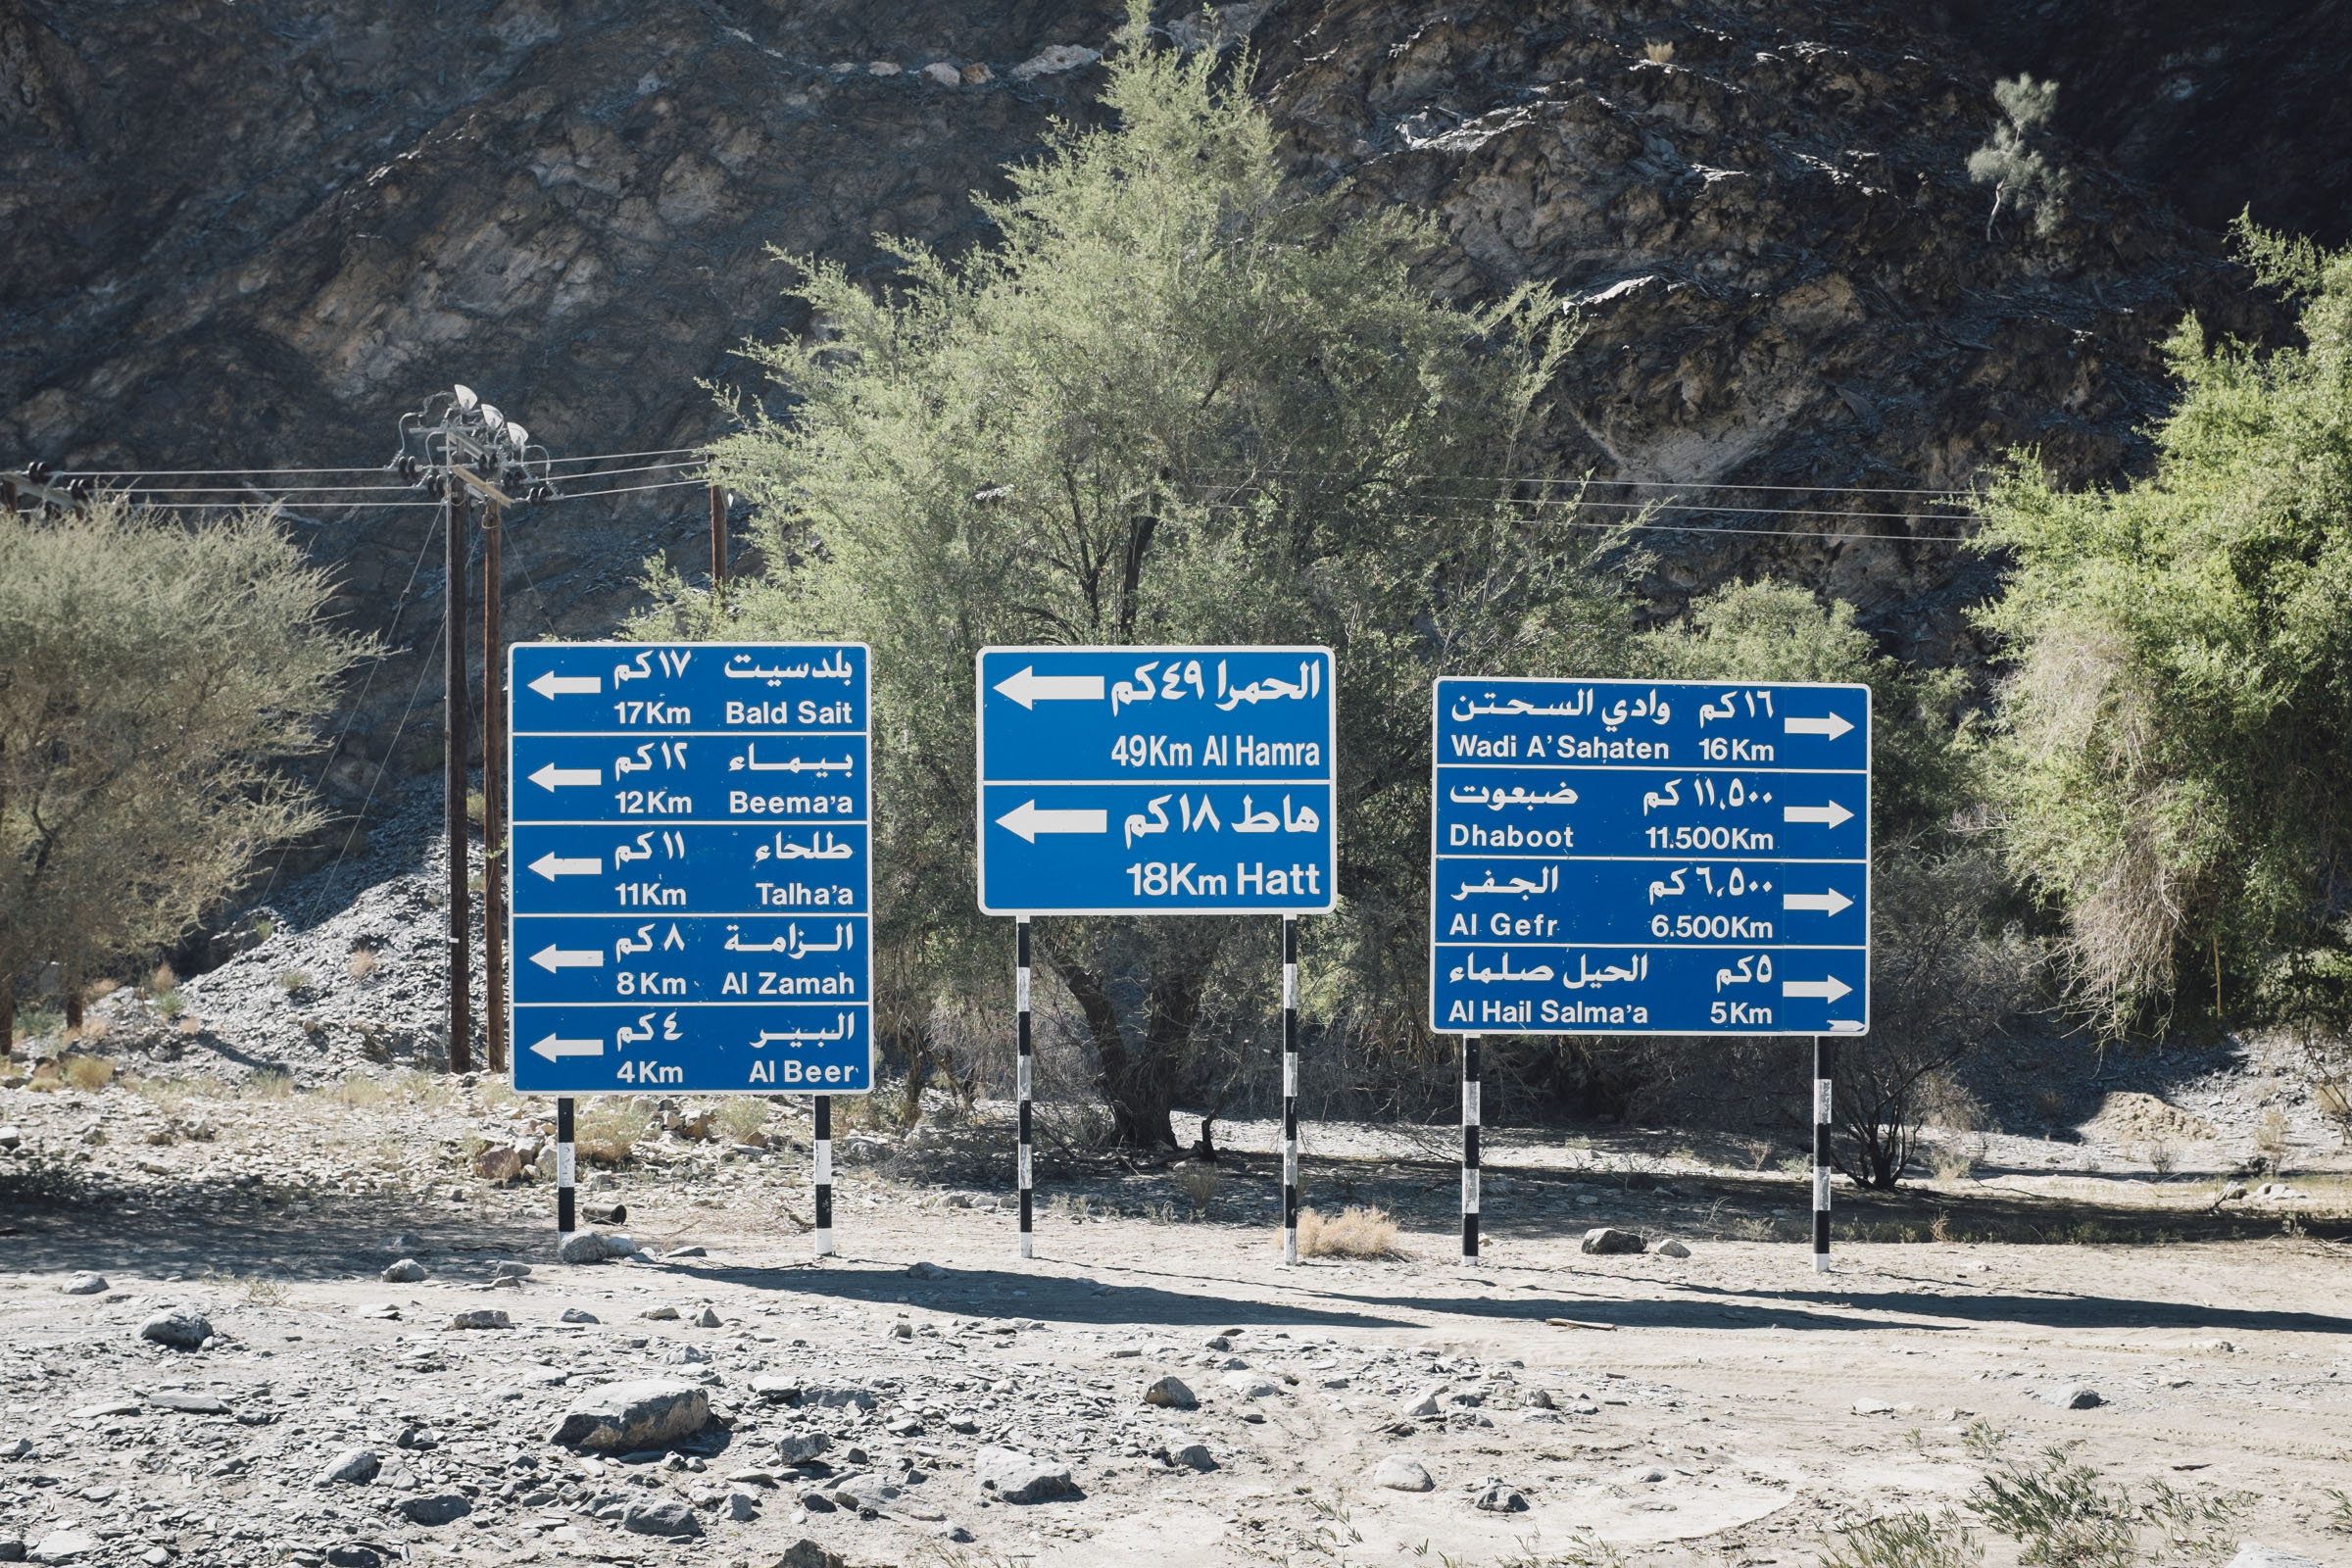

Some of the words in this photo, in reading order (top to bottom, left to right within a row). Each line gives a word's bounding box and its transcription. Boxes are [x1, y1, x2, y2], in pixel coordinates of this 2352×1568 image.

[1215, 660, 1319, 710] الحمرا
[727, 702, 787, 723] Bald
[798, 701, 852, 723] Sait
[1452, 689, 1592, 721] السحتن
[1602, 689, 1670, 732] وادي
[729, 743, 853, 777] بيماء
[1202, 736, 1227, 765] Al
[1237, 735, 1319, 765] Hamra
[1451, 735, 1516, 757] Wadi
[1450, 782, 1578, 810] ضبعوت
[1232, 795, 1319, 832] هاط
[756, 831, 853, 861] طلحاء
[1450, 824, 1573, 847] Dhaboot
[1238, 862, 1319, 895] Hatt
[1451, 865, 1558, 901] الجفر
[1449, 913, 1476, 935] Al
[1491, 913, 1557, 936] Gefr
[724, 922, 853, 959] الزامة
[722, 972, 747, 994] Al
[759, 972, 854, 994] Zamah
[1450, 953, 1554, 983] صلماء
[1563, 954, 1647, 989] الحيل
[1448, 1001, 1473, 1021] Al
[1483, 1001, 1531, 1022] Hail
[750, 1012, 854, 1048] البير
[750, 1060, 774, 1082] Al
[785, 1060, 854, 1082] Beer
